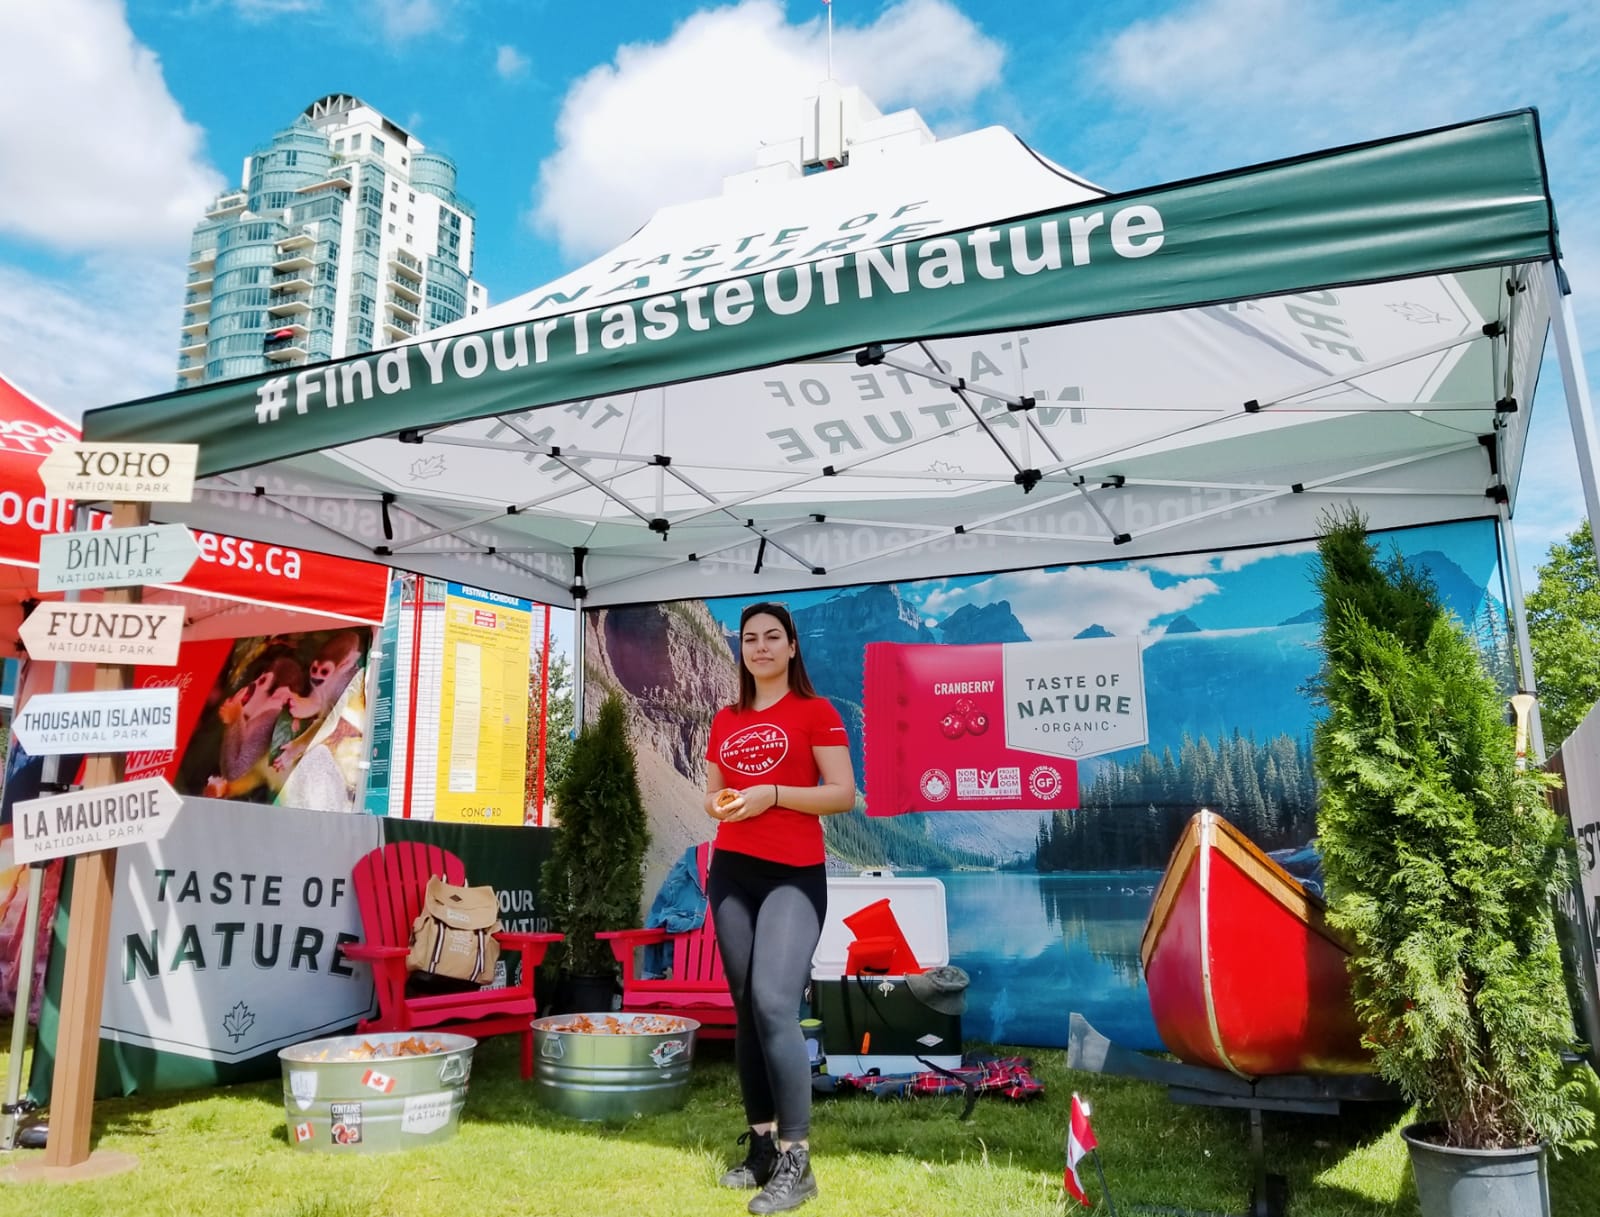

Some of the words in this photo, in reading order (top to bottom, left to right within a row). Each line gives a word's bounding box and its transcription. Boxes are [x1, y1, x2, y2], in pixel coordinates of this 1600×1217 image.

[608, 226, 809, 273] TASTE
[838, 200, 929, 231] OF
[527, 219, 943, 311] NATURE
[254, 203, 1166, 424] #FindYourTasteOfNature
[74, 450, 171, 478] YOHO
[67, 481, 131, 492] NATIONAL
[135, 483, 171, 493] PARK
[67, 532, 160, 570] BANFF
[56, 571, 122, 585] NATIONAL
[127, 567, 164, 578] PARK
[47, 611, 167, 641] FUNDY
[48, 642, 114, 654] NATIONAL
[119, 644, 155, 655] PARK
[934, 680, 996, 696] CRANBERRY
[1025, 675, 1087, 691] TASTE
[1095, 674, 1120, 688] OF
[1017, 694, 1132, 719] NATURE
[24, 709, 102, 732] THOUSAND
[107, 706, 172, 728] ISLANDS
[1041, 721, 1110, 733] ORGANIC
[40, 731, 107, 744] NATIONAL
[113, 729, 149, 739] PARK
[723, 750, 739, 759] FIND
[737, 758, 774, 771] NATURE
[1036, 777, 1054, 788] GF
[24, 810, 49, 840] LA
[56, 789, 160, 834] MAURICIE
[460, 807, 502, 818] CONCORD
[35, 833, 103, 852] NATIONAL
[108, 824, 145, 840] PARK
[154, 868, 283, 906] TASTE
[302, 876, 346, 908] OF
[122, 922, 361, 984] NATURE
[407, 1110, 447, 1124] NATURE
